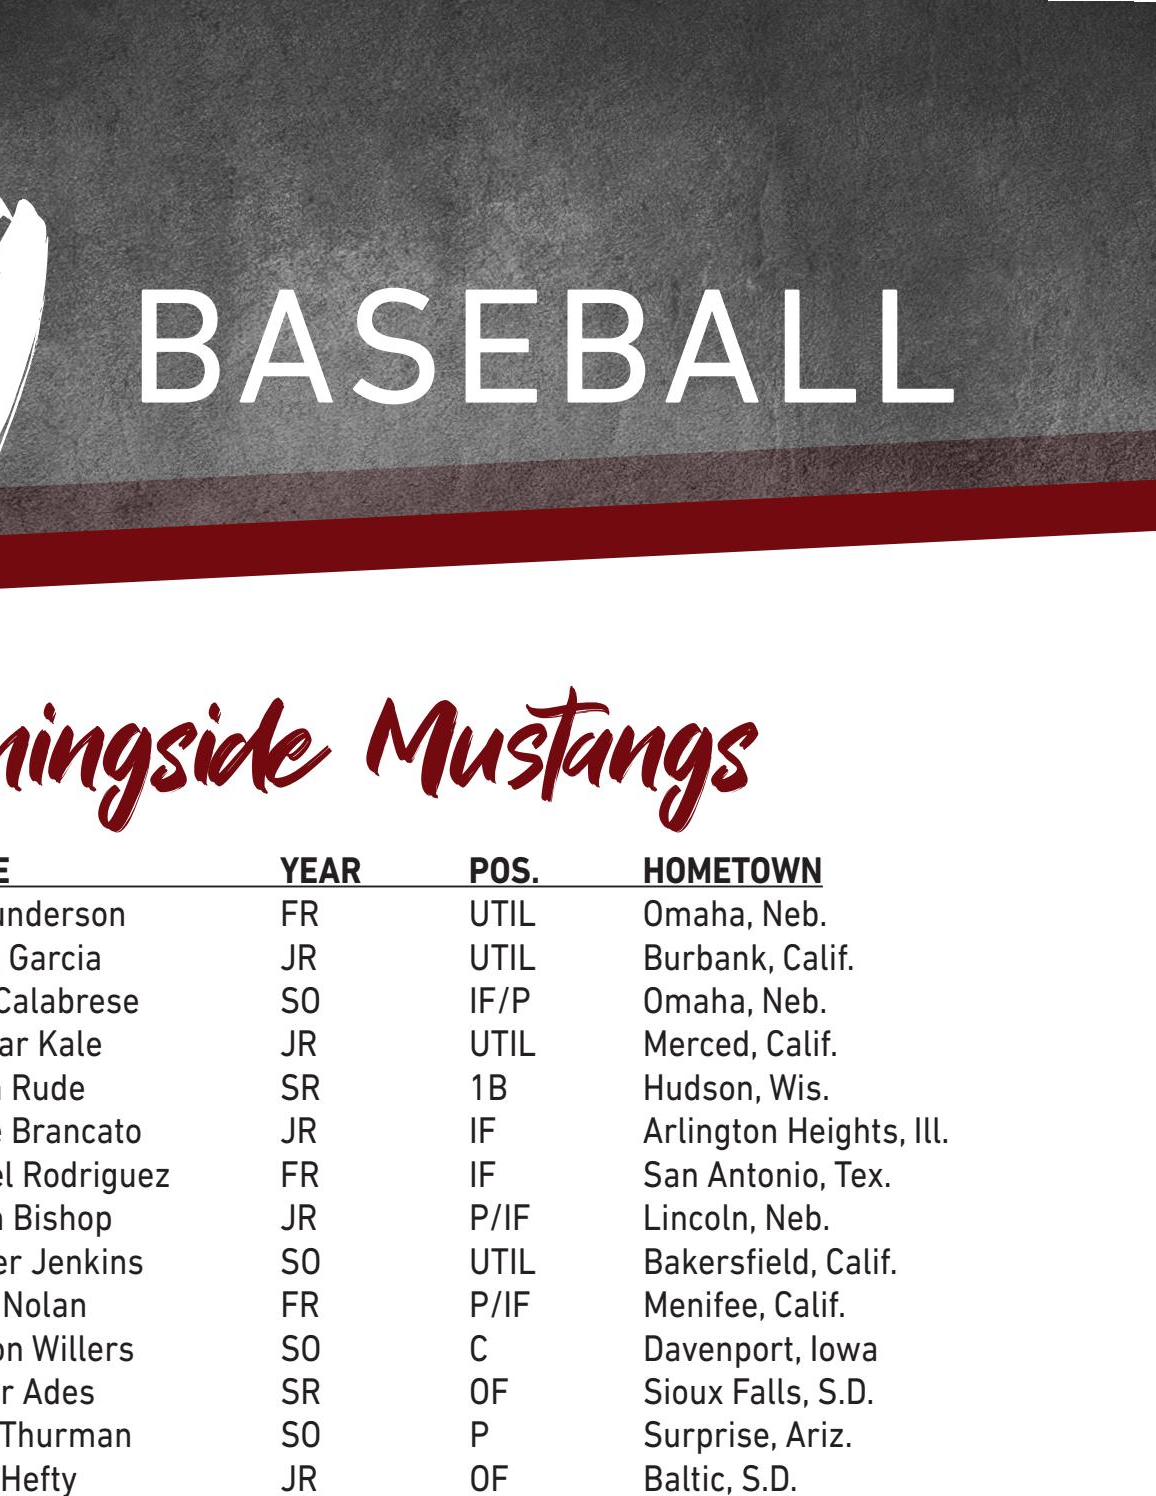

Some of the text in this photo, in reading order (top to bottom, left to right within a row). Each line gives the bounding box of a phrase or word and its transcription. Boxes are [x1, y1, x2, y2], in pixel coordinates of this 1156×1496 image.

[141, 287, 955, 405] BASEBALL
[366, 687, 759, 833] Mustangs
[280, 856, 361, 884] YEAR
[470, 856, 539, 884] POS.
[644, 856, 822, 885] HOMETOWN
[282, 899, 319, 927] FR
[470, 899, 536, 927] UTIL
[644, 899, 753, 930] Omaha,
[763, 899, 826, 927] Neb.
[281, 986, 320, 1014] SO
[471, 986, 530, 1014] IF/P
[644, 986, 753, 1018] Omaha,
[763, 986, 826, 1014] Neb.
[13, 1116, 141, 1144] Brancato
[280, 1116, 317, 1144] JR
[471, 1116, 496, 1144] IF
[643, 1116, 777, 1151] Arlington
[788, 1116, 905, 1151] Heights,
[915, 1116, 948, 1144] Ill.
[14, 1203, 112, 1238] Bishop
[280, 1203, 317, 1231] JR
[471, 1203, 531, 1232] P/IF
[644, 1203, 756, 1234] Lincoln,
[766, 1203, 829, 1232] Neb.
[32, 1334, 134, 1362] Willers
[281, 1334, 320, 1362] SO
[470, 1334, 488, 1362] C
[645, 1334, 801, 1369] Davenport,
[811, 1334, 877, 1362] Iowa
[281, 1420, 320, 1448] SO
[471, 1420, 489, 1448] P
[644, 1420, 777, 1455] Surprise,
[785, 1420, 851, 1448] Ariz.
